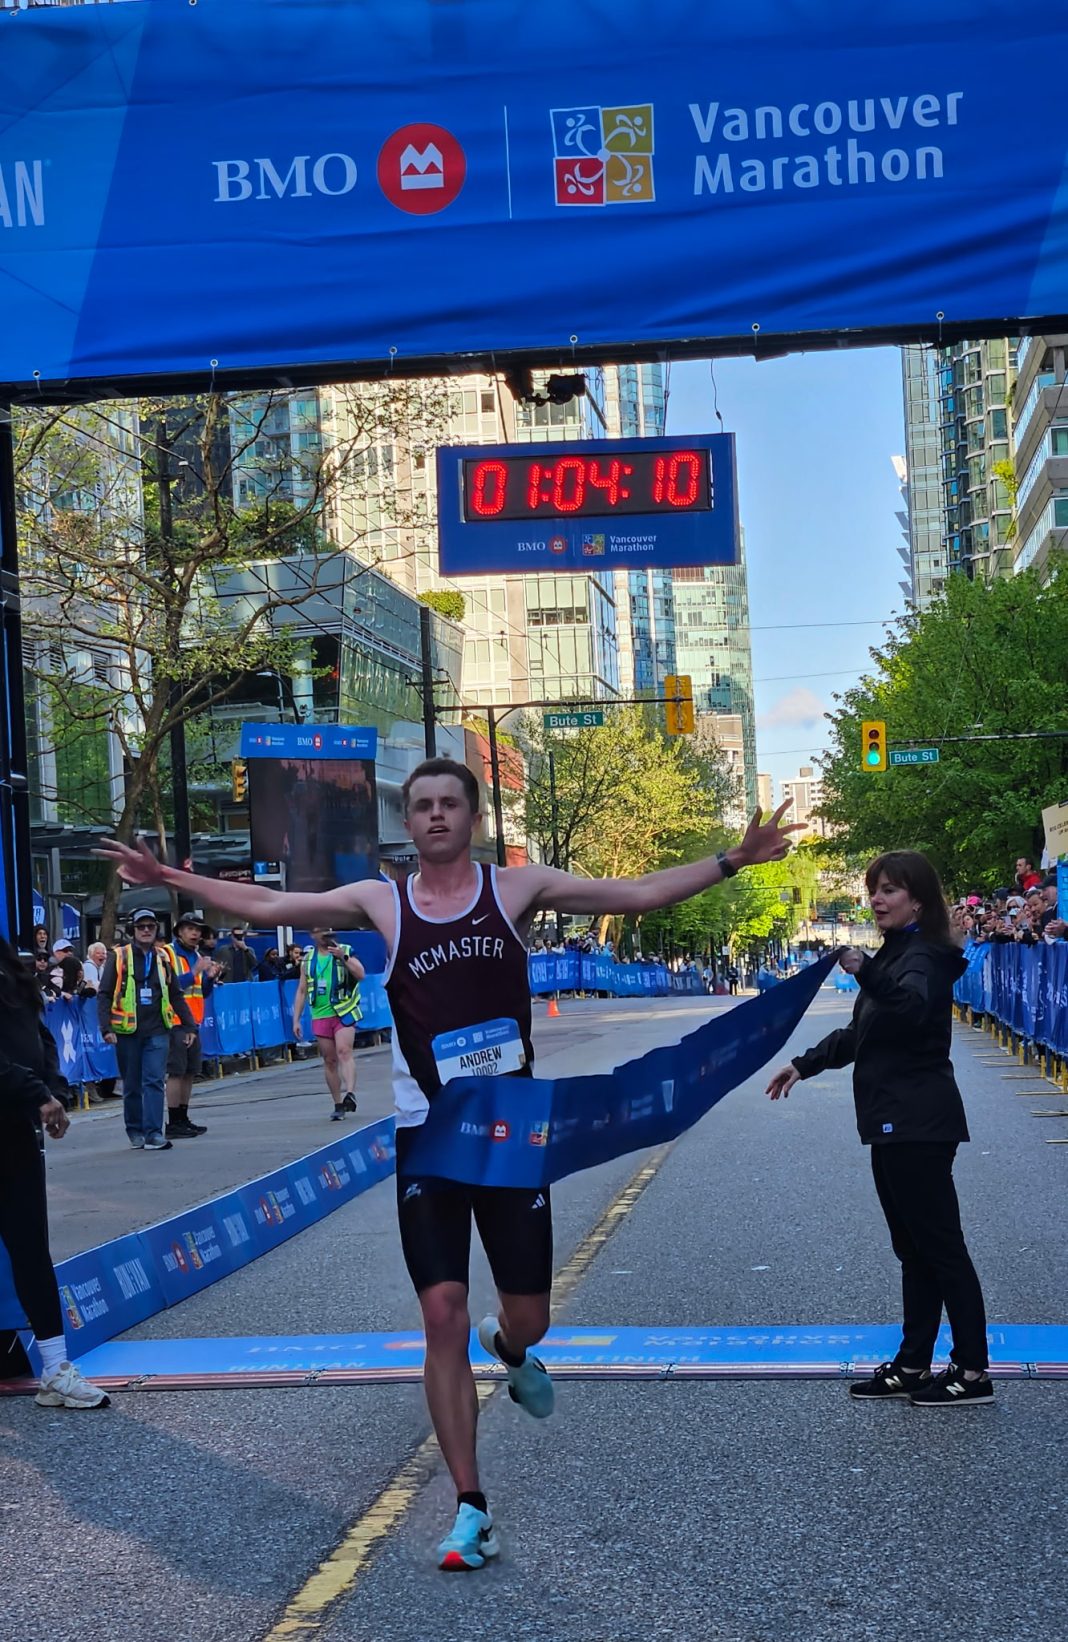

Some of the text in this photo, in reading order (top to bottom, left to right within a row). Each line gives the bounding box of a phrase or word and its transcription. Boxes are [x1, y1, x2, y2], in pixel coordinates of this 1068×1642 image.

[689, 91, 964, 143] Vancouver
[692, 138, 944, 195] Marathon
[212, 152, 358, 202] BMO
[517, 540, 546, 552] BMO
[609, 534, 657, 544] Vancouver
[609, 542, 654, 553] Marathon
[549, 714, 598, 727] Bute St
[894, 751, 933, 763] Bute St
[408, 936, 504, 979] MCMASTER
[459, 1045, 502, 1070] ANDREW
